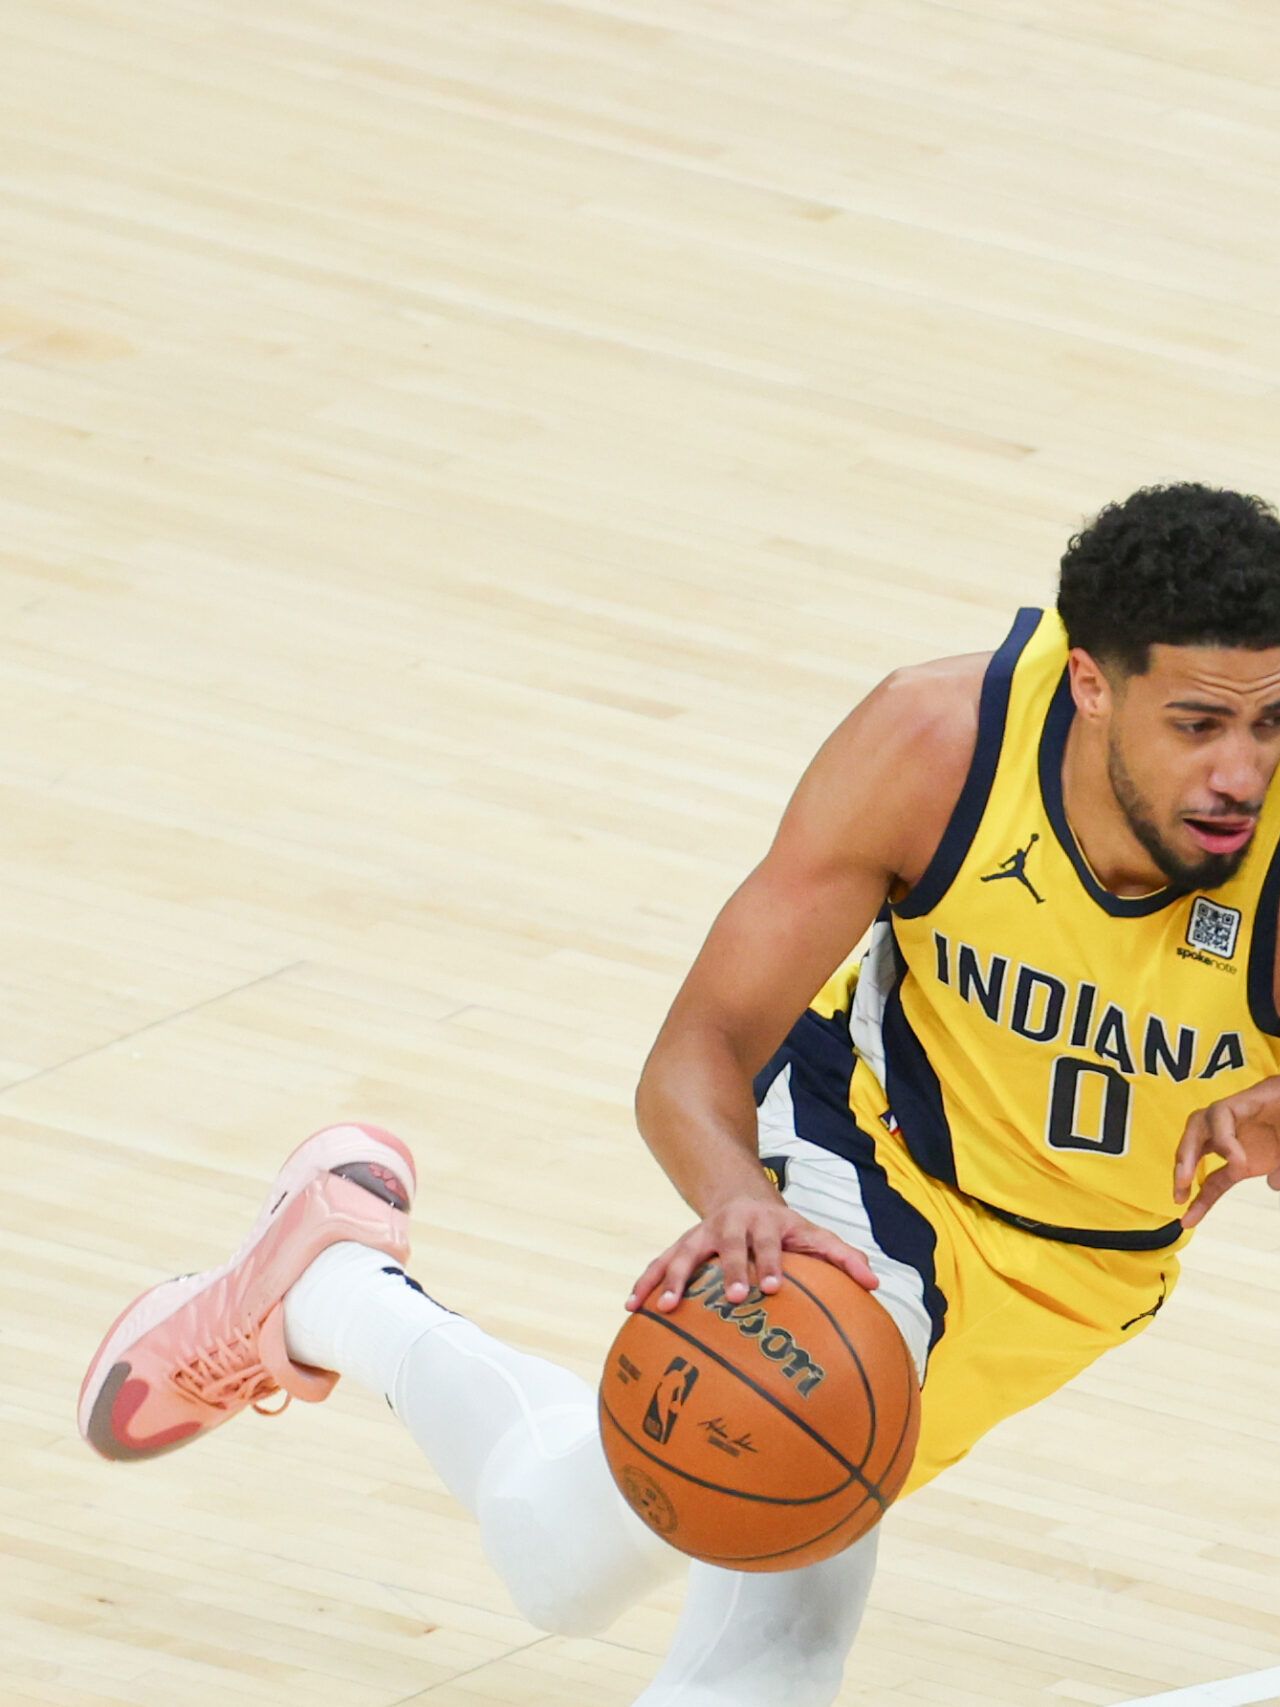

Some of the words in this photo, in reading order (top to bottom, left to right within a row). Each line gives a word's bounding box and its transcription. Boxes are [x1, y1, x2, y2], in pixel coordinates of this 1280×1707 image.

[932, 928, 1246, 1083] INDIANA
[1177, 947, 1237, 974] spokenote
[1046, 1054, 1132, 1156] 0
